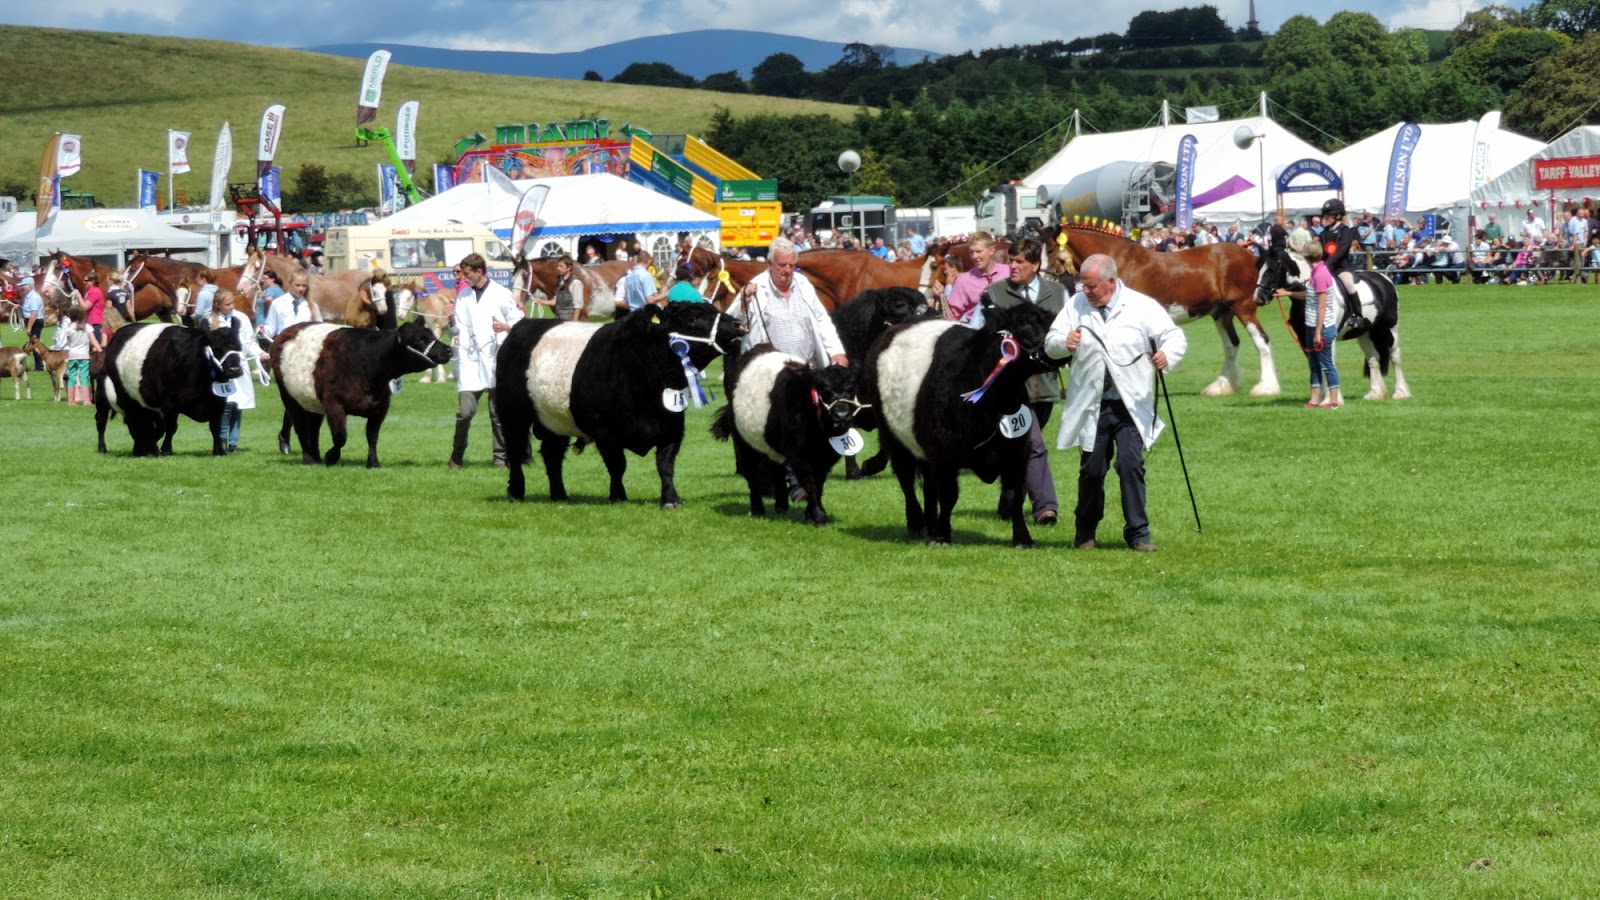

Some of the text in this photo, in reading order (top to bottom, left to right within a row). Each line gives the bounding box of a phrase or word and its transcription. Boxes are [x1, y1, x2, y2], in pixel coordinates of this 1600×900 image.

[264, 122, 273, 152] CASE
[1182, 138, 1192, 162] LTD
[1280, 161, 1336, 185] CRAIG WILSON LTD
[1391, 153, 1409, 203] WILSON
[1400, 126, 1414, 151] LTD
[1539, 164, 1600, 180] TARFF VALLEY
[1179, 164, 1189, 212] WILSON
[494, 270, 509, 278] LTD
[220, 384, 232, 394] 16
[673, 393, 684, 406] 15
[1011, 413, 1026, 432] 20
[839, 435, 856, 450] 30
